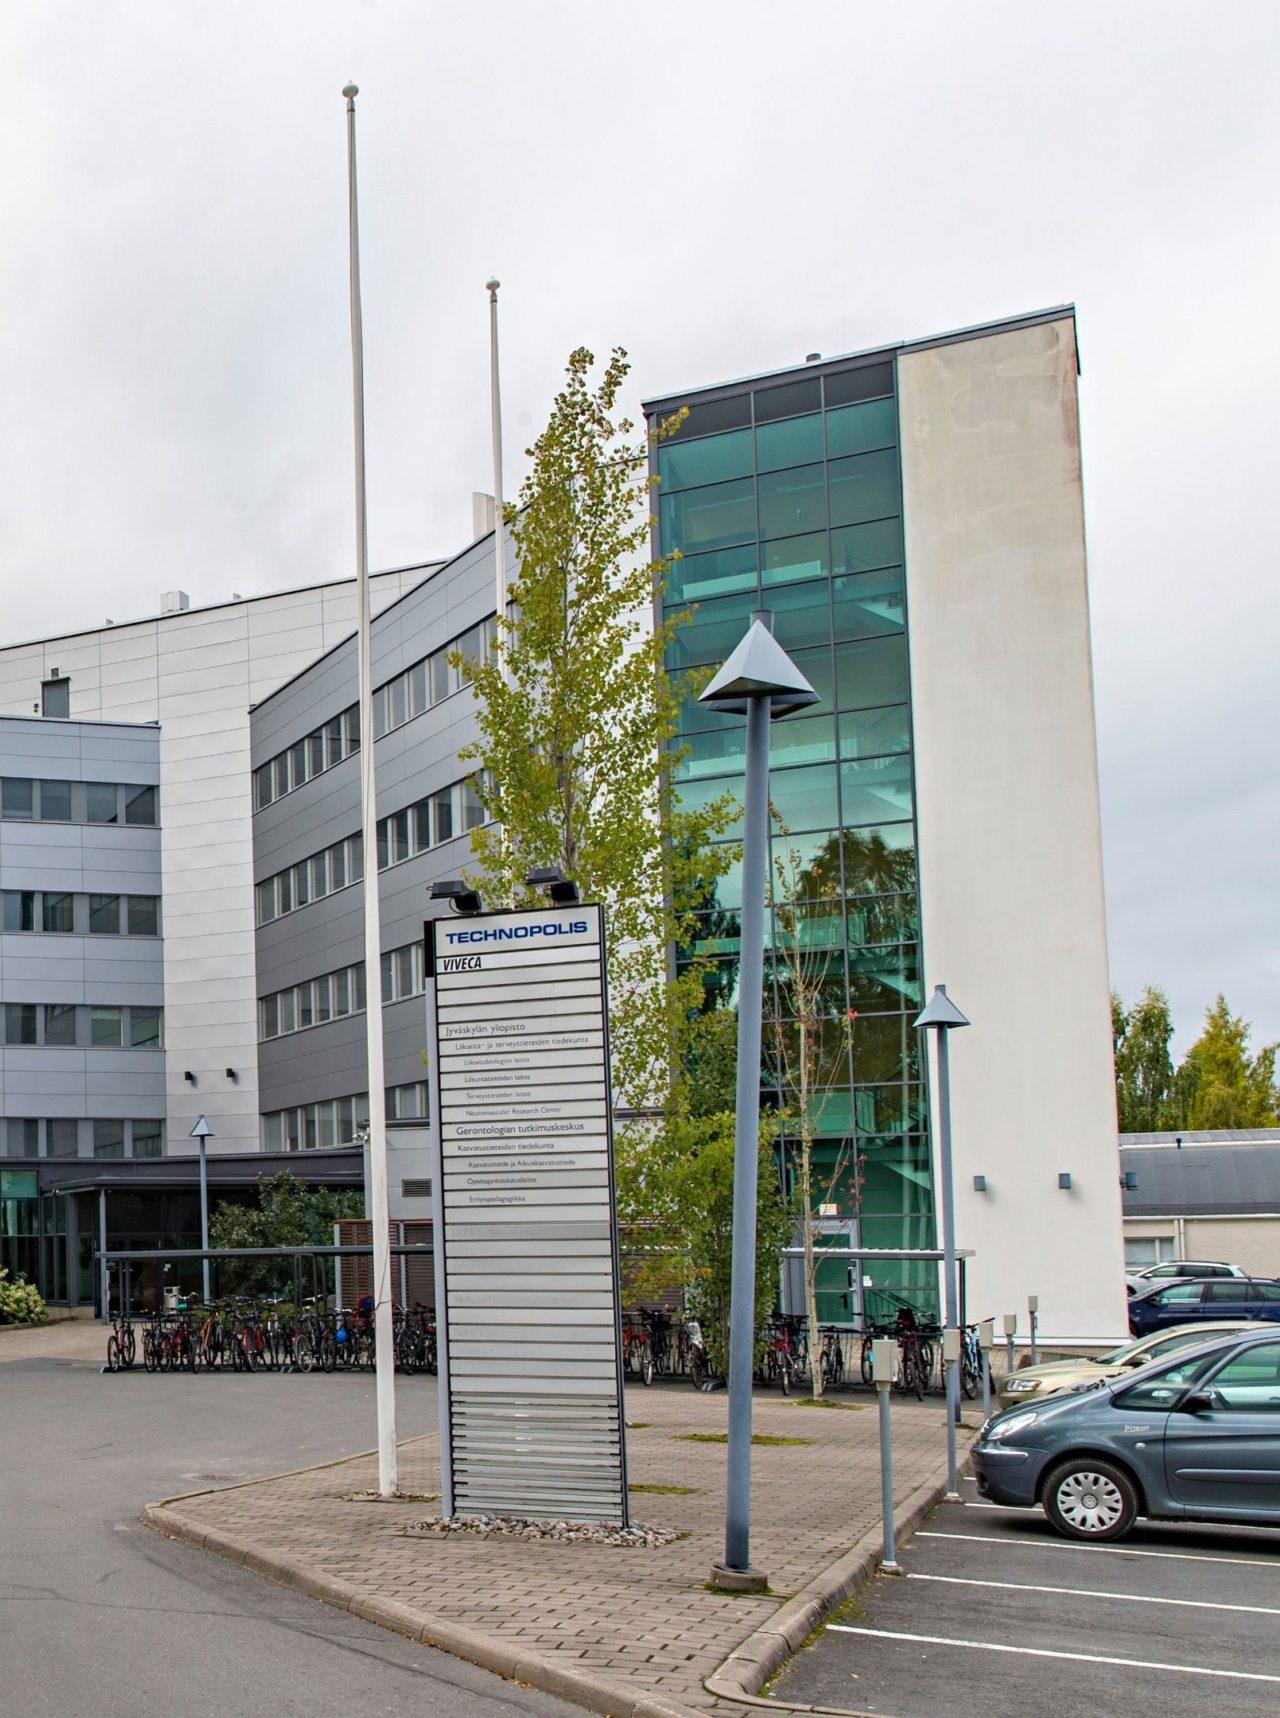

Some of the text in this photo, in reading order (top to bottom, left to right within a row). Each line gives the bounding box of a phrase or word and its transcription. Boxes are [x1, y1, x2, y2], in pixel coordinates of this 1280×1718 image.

[445, 921, 588, 944] TECHNOPOLIS
[443, 956, 482, 972] VIVECA
[445, 1023, 526, 1037] Jyväskylän yliopisto
[487, 1042, 493, 1051] ja
[552, 1037, 589, 1046] tiedekunta
[466, 1106, 562, 1118] Neuromuscular Research Center
[456, 1121, 585, 1136] Gerontologian tutkimuskeskus
[457, 1142, 555, 1152] Kasvatustieteiden tiedekunta
[510, 1160, 516, 1169] ja
